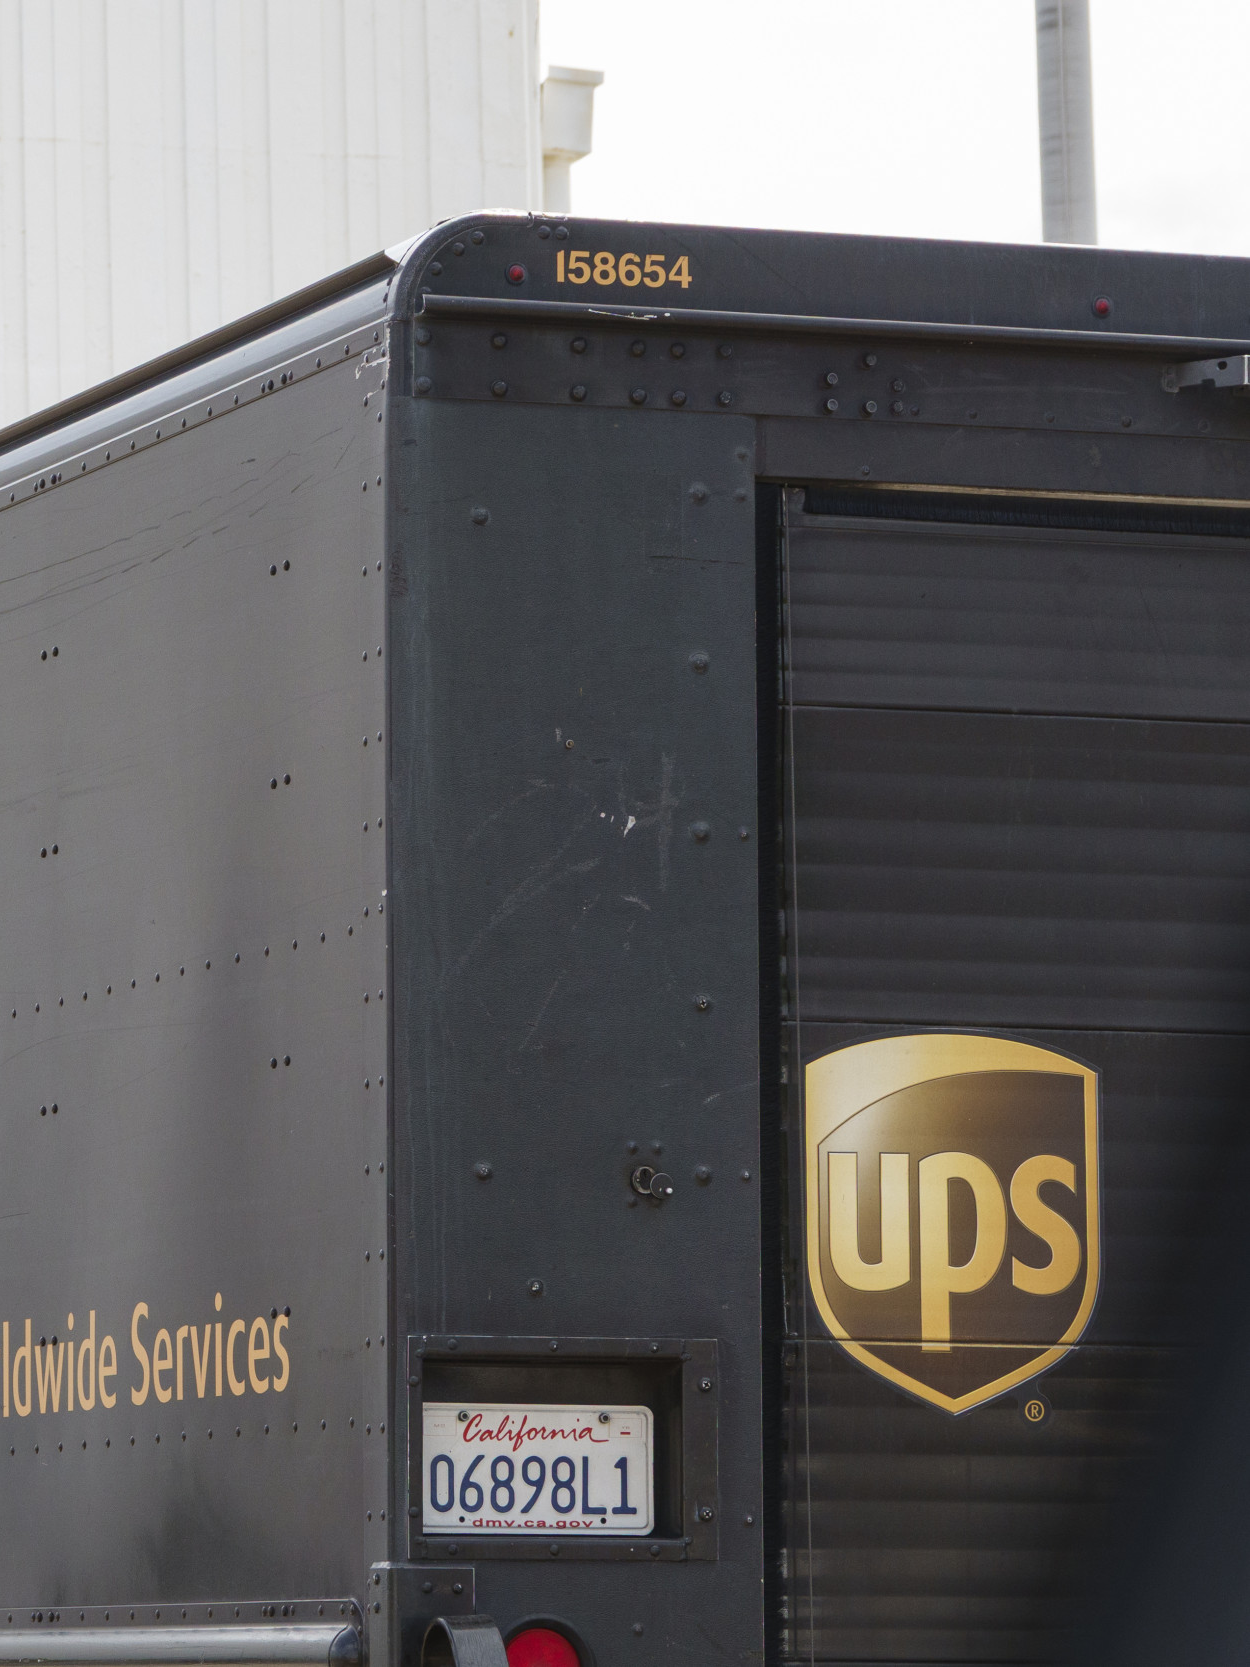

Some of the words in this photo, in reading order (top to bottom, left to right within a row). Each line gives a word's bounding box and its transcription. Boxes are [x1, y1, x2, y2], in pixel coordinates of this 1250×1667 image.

[556, 249, 693, 289] 158654
[828, 1151, 1081, 1353] ups
[130, 1291, 291, 1406] Services
[462, 1413, 609, 1452] California
[430, 1454, 638, 1515] 06898L1
[472, 1518, 593, 1529] dmv.ca.gov
